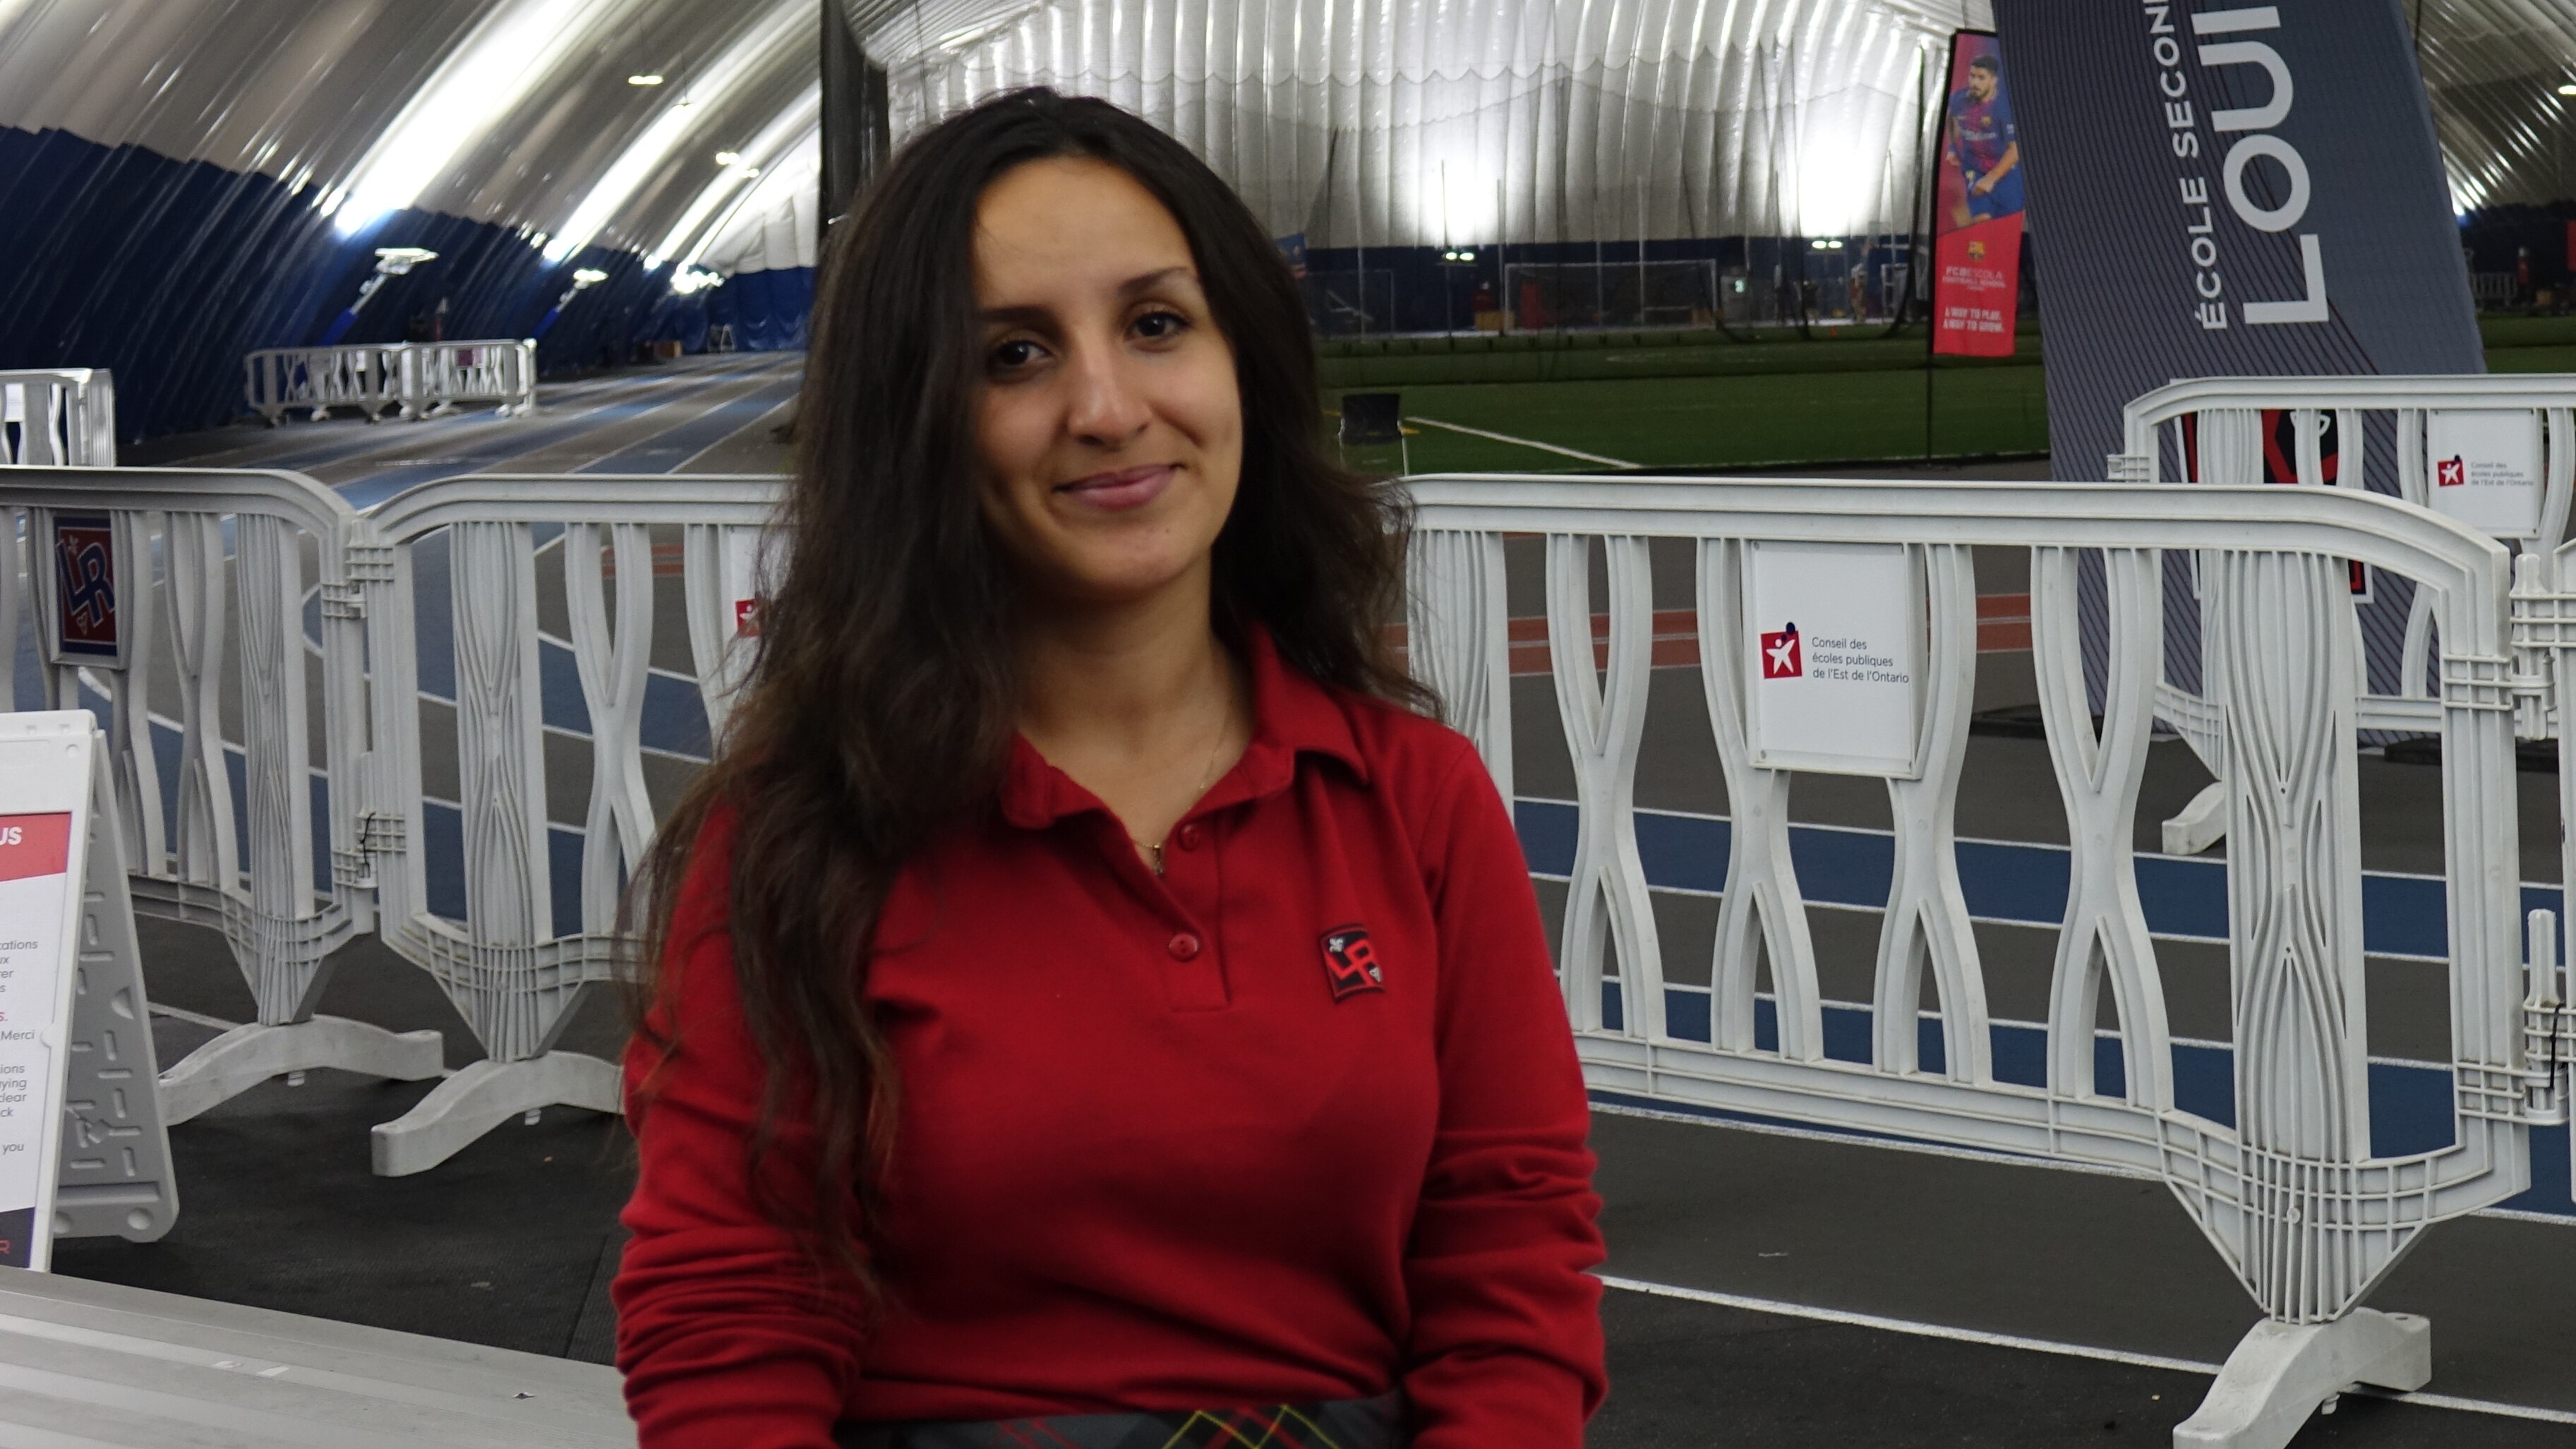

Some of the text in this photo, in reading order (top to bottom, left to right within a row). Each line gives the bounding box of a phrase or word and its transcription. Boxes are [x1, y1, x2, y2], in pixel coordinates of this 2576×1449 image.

[2142, 0, 2227, 330] ÉCOLE SECON
[2191, 6, 2329, 324] LOUI
[1812, 637, 1867, 649] Conseil des
[1812, 652, 1893, 668] écoles publiques
[1812, 668, 1909, 683] de l'Est de l'Ontario
[1, 1029, 35, 1041] Merci
[0, 1078, 27, 1091] ying
[2, 1143, 24, 1155] you
